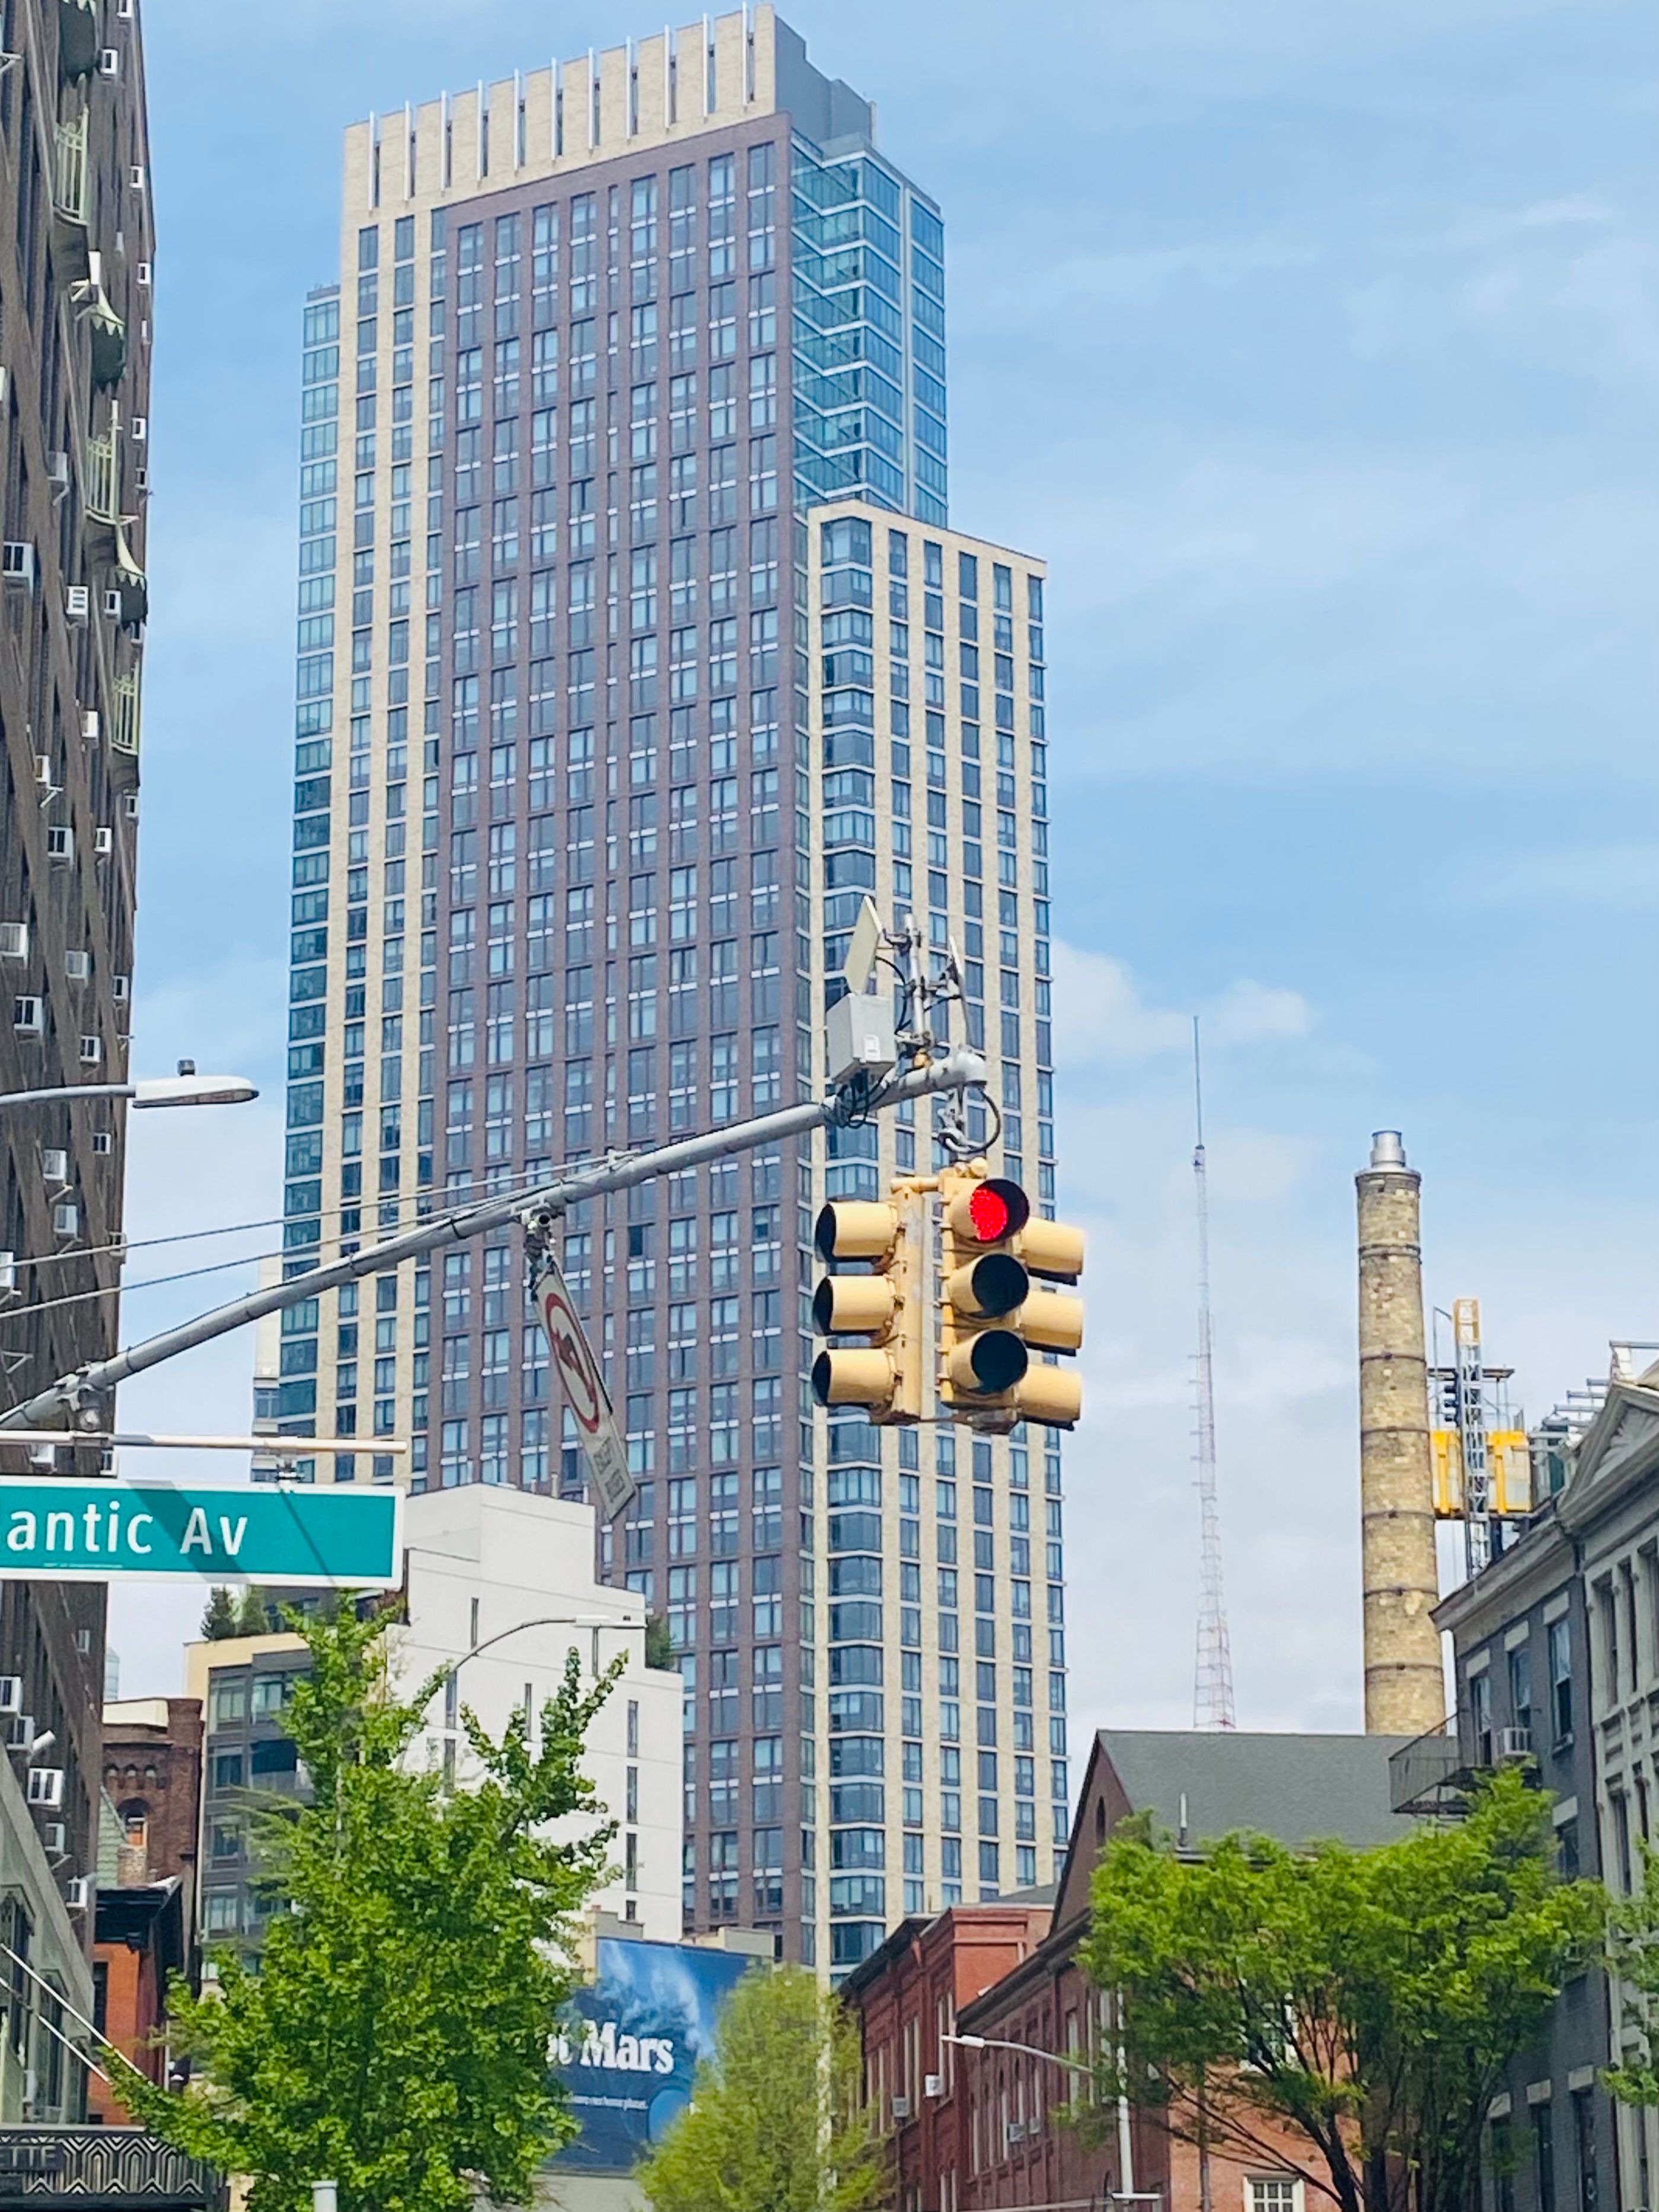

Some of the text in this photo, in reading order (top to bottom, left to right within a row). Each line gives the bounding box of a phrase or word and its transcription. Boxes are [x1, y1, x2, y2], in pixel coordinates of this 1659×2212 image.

[7, 1500, 248, 1556] antic Av
[580, 2019, 675, 2074] Mars
